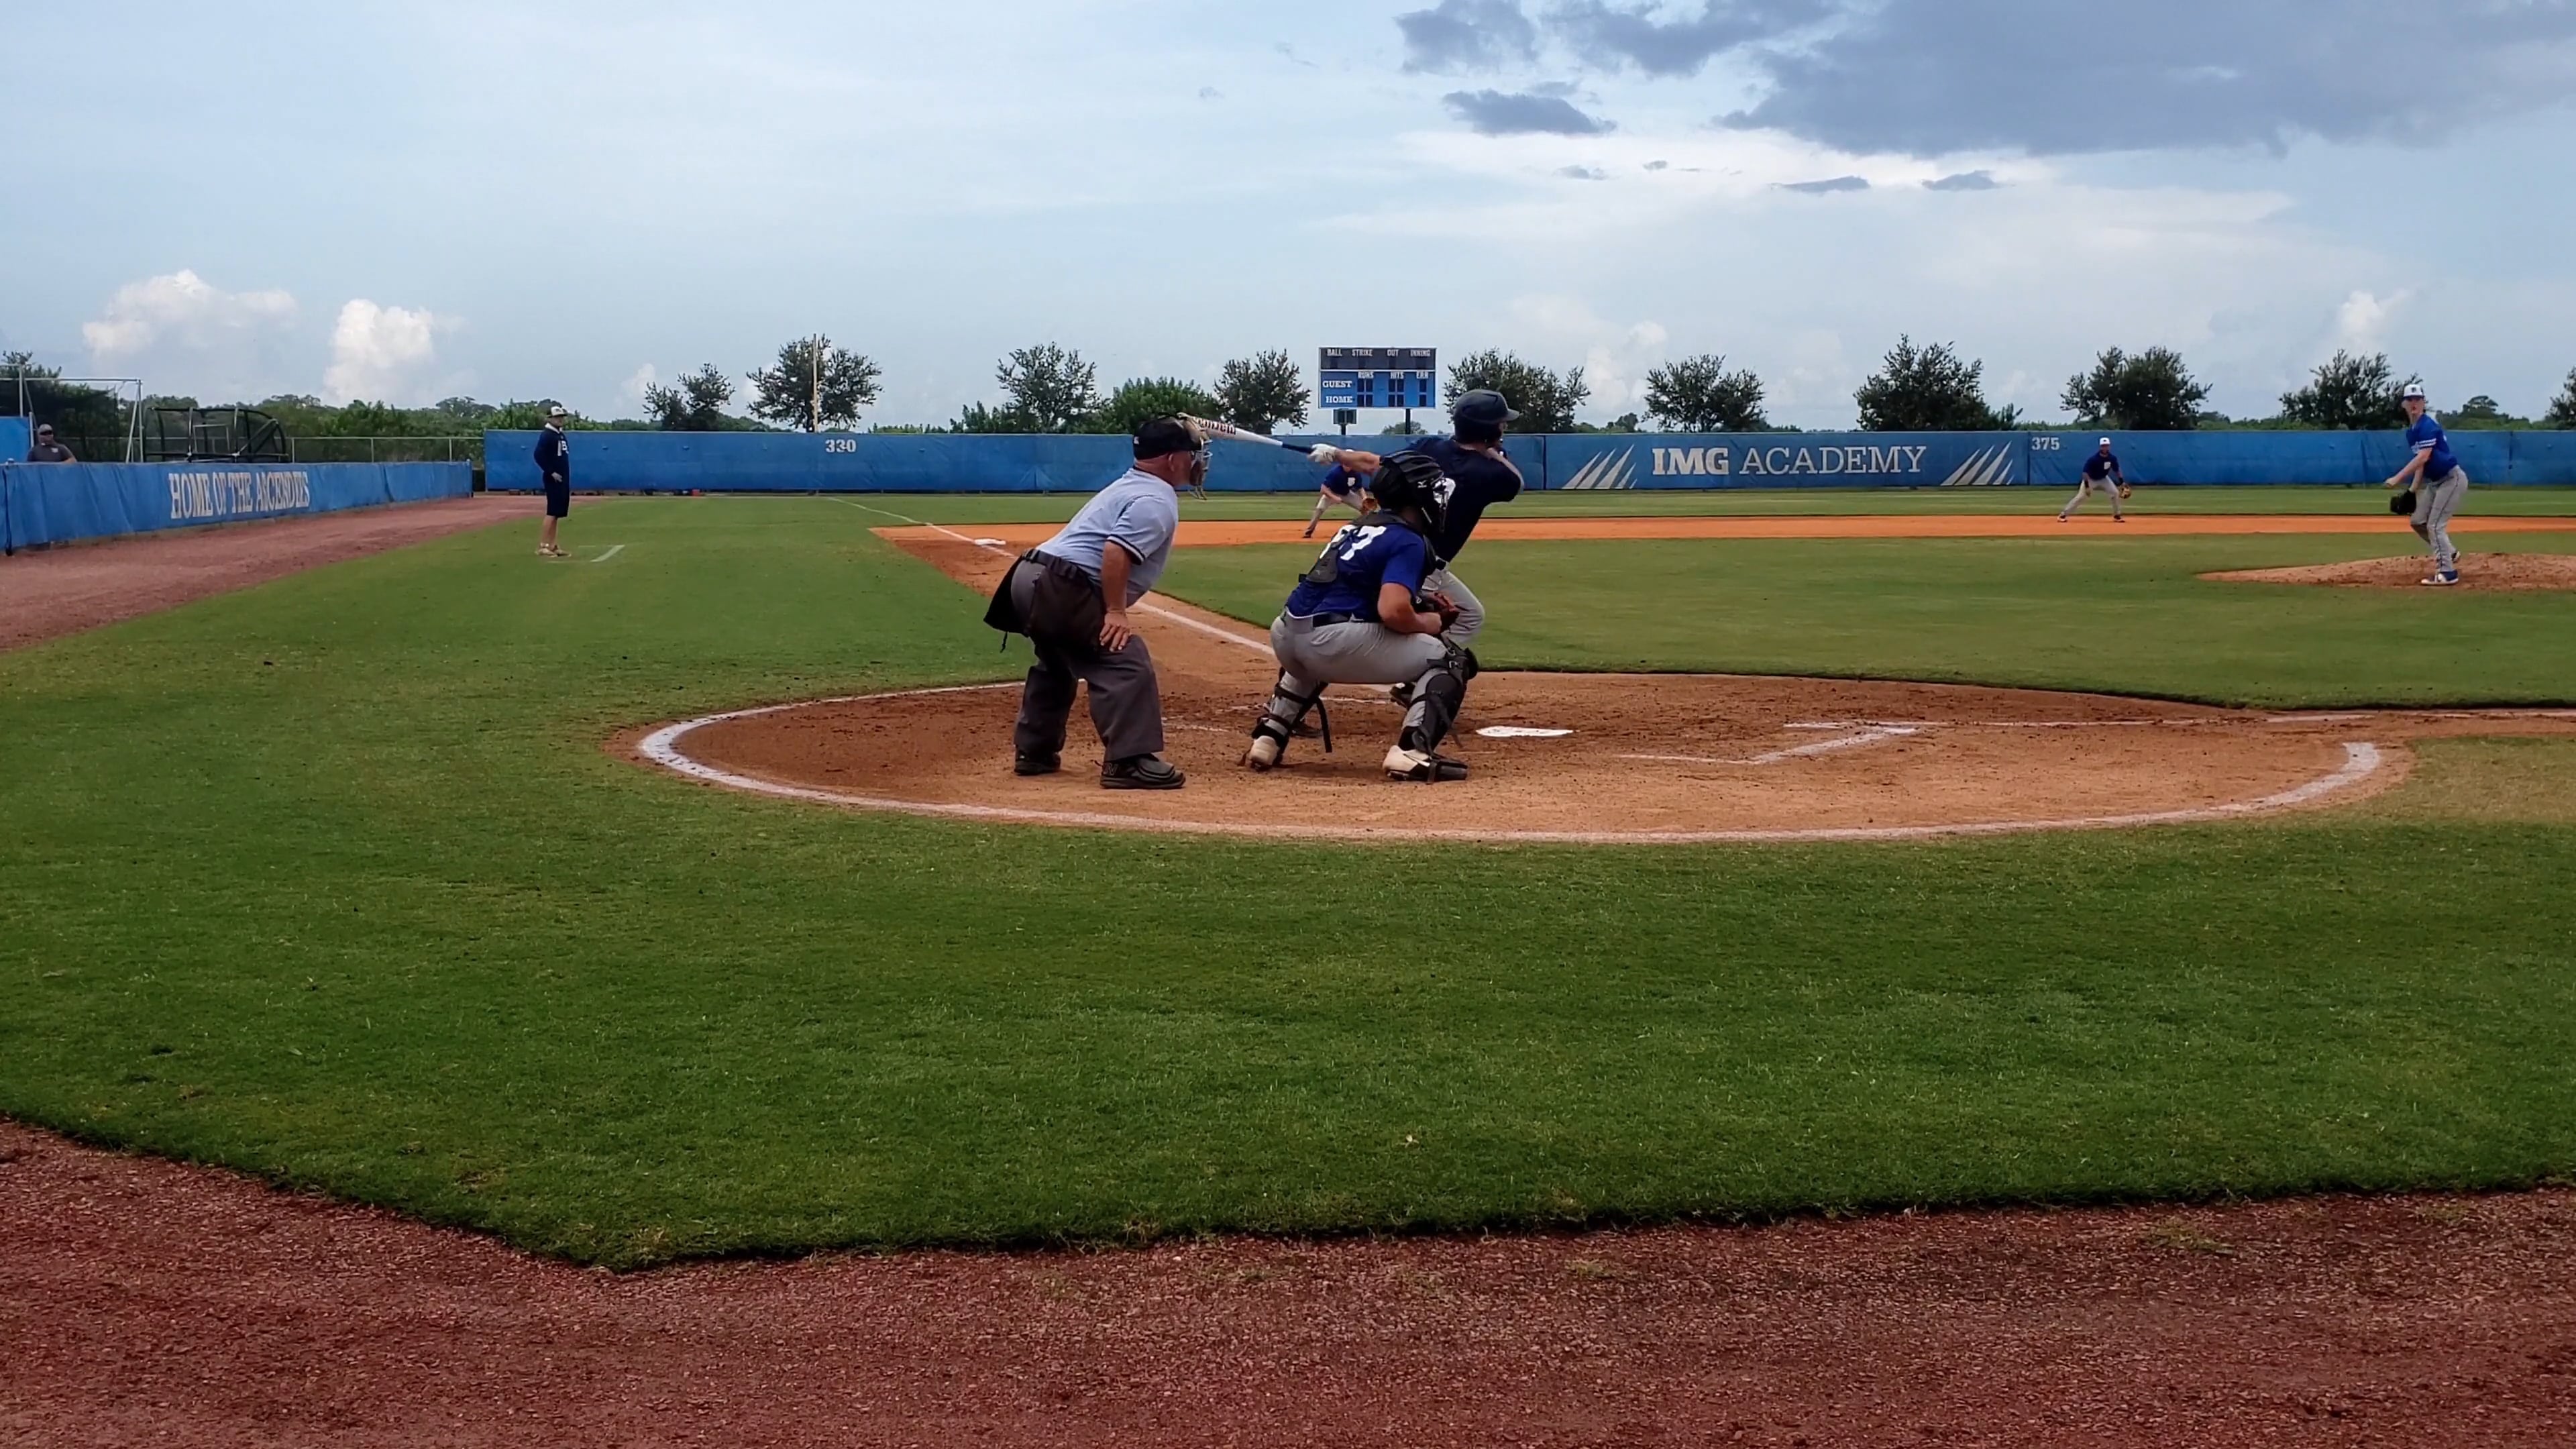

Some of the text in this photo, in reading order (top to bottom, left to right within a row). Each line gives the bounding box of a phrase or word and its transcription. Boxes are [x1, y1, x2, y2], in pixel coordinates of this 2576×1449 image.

[1327, 348, 1342, 356] BALL
[1358, 371, 1374, 379] RUNS
[1390, 371, 1404, 379] HITS
[825, 439, 857, 453] 330
[2031, 437, 2060, 450] 375
[1652, 445, 1927, 475] IMG ACADEMY
[168, 472, 213, 519] HOME
[212, 471, 227, 515] OF
[227, 472, 253, 514] THE
